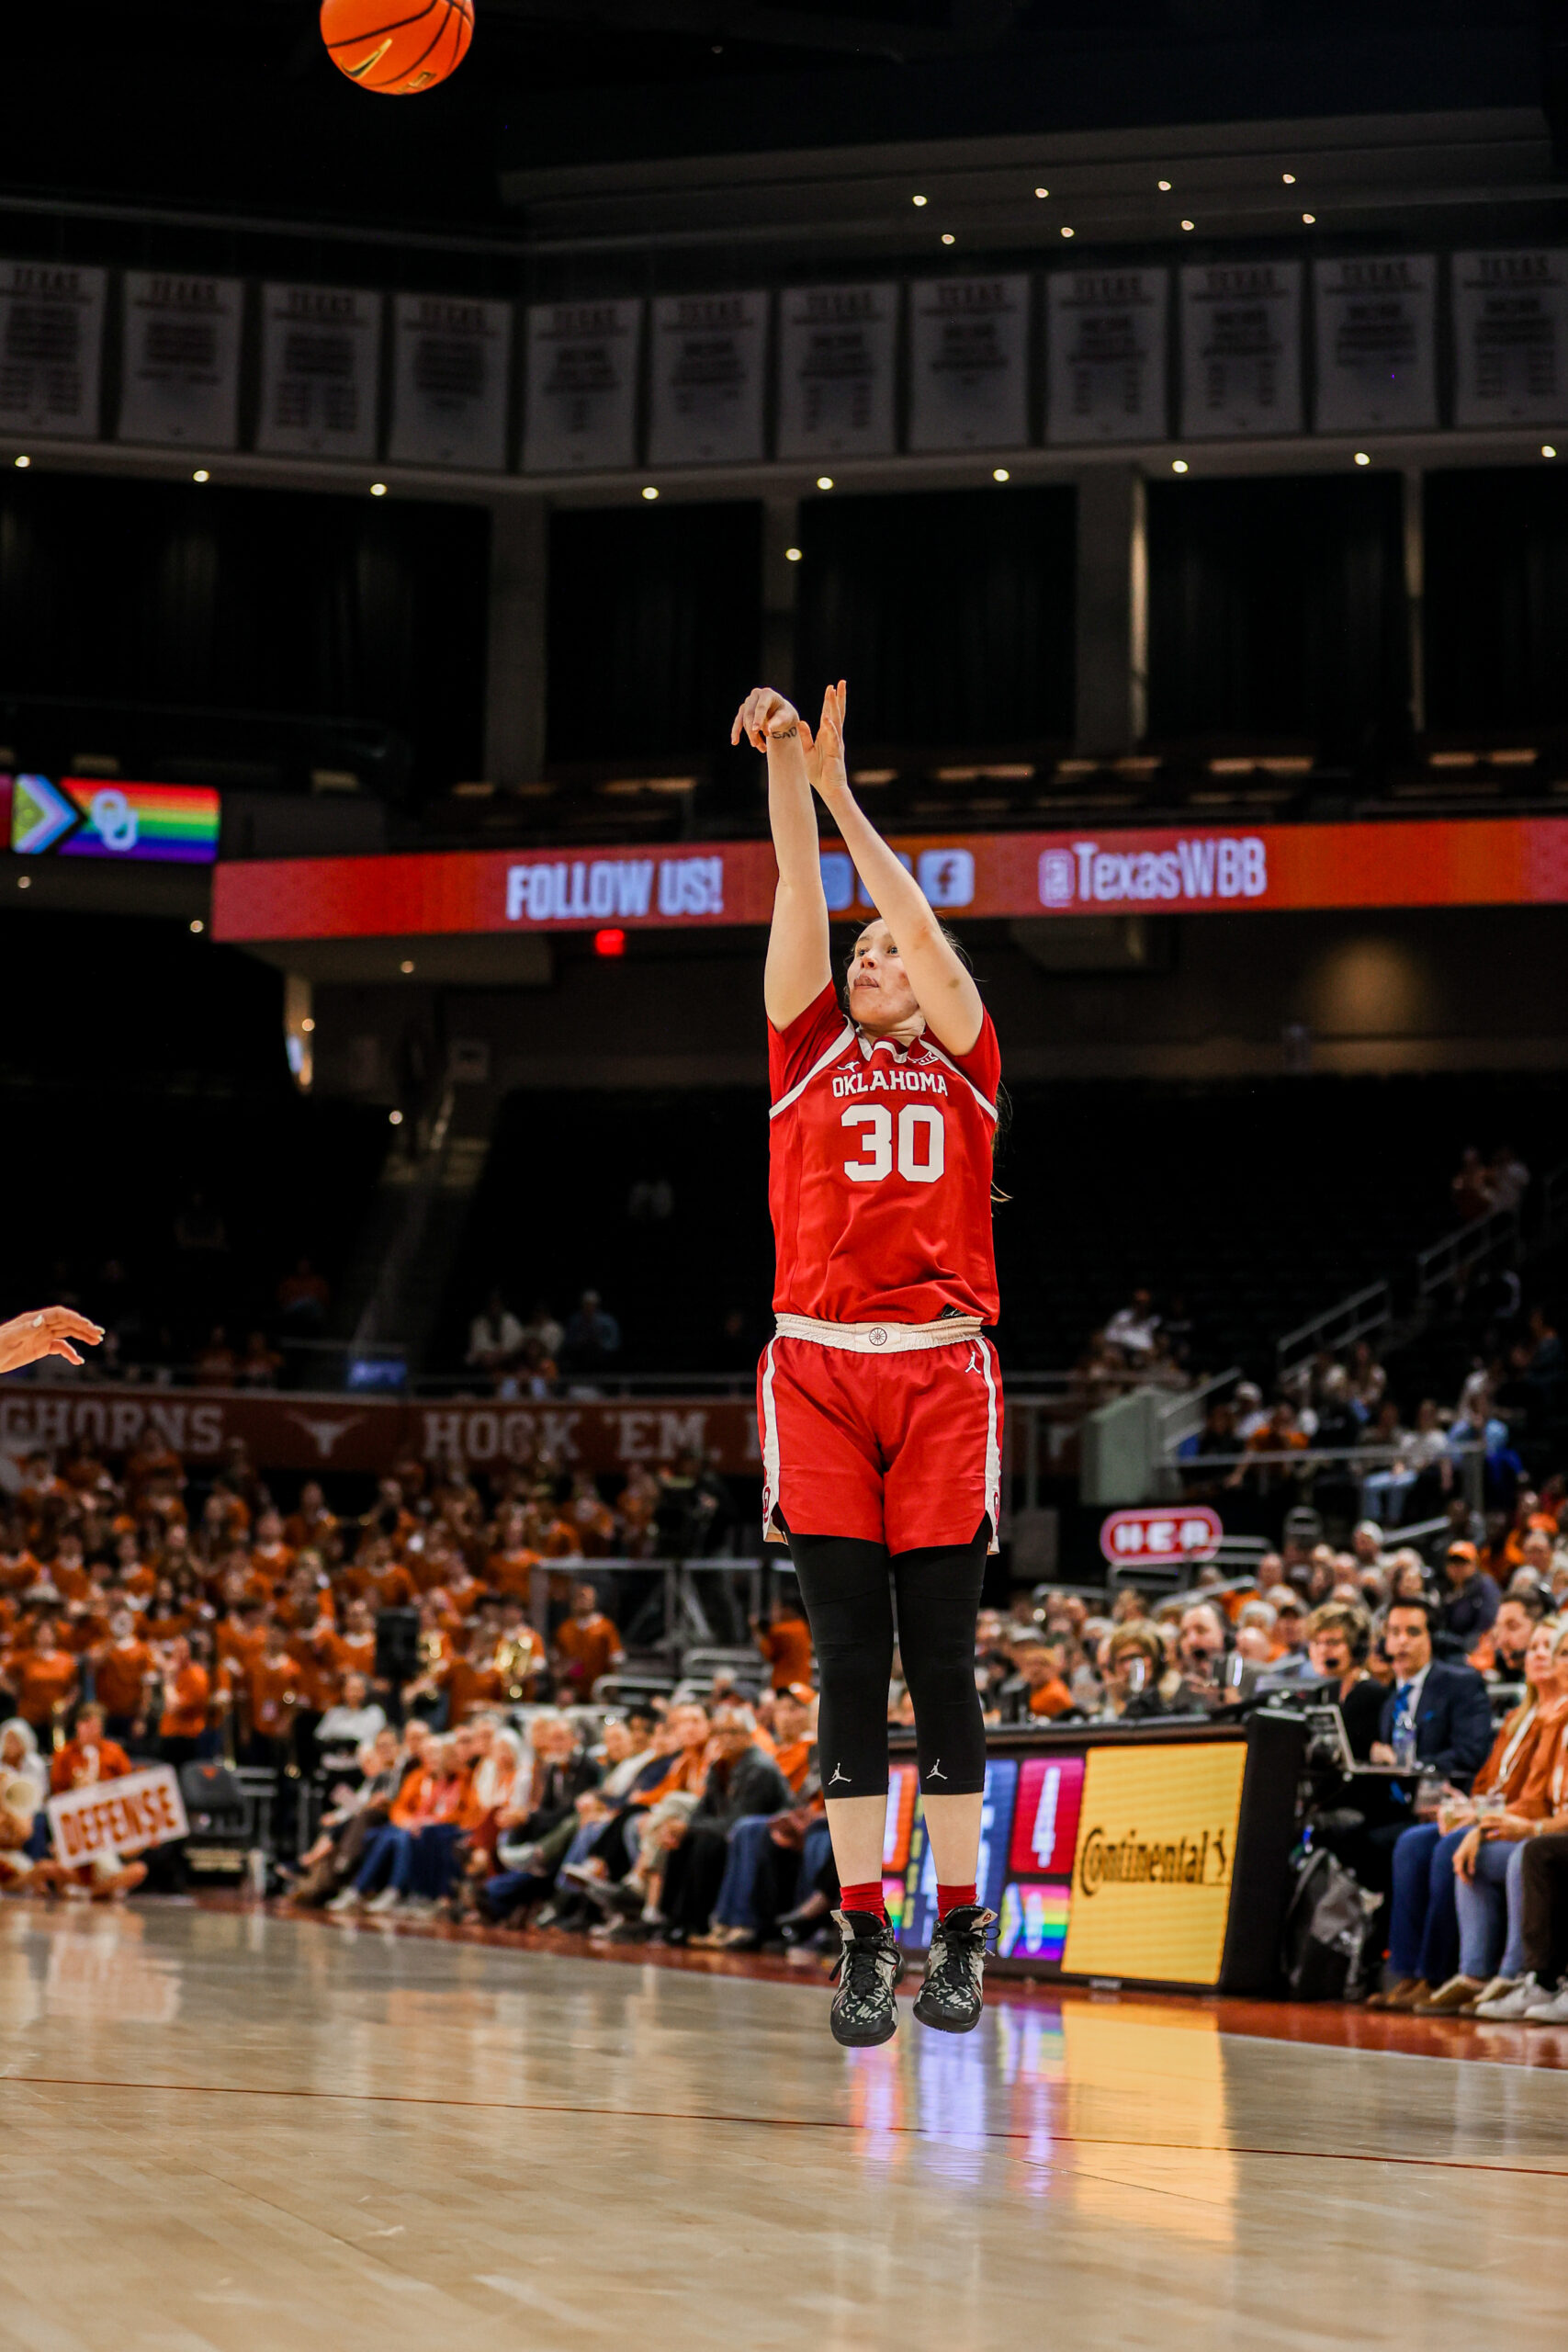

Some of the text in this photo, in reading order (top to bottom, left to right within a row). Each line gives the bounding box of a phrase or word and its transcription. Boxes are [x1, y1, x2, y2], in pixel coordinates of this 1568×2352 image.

[507, 855, 724, 920] FOLLOW US!
[1039, 837, 1268, 908] @TexasWBB
[832, 1069, 949, 1099] OKLAHOMA
[840, 1103, 945, 1183] 30
[60, 1785, 176, 1857] DEFENSE
[1080, 1826, 1209, 1898] Continental
